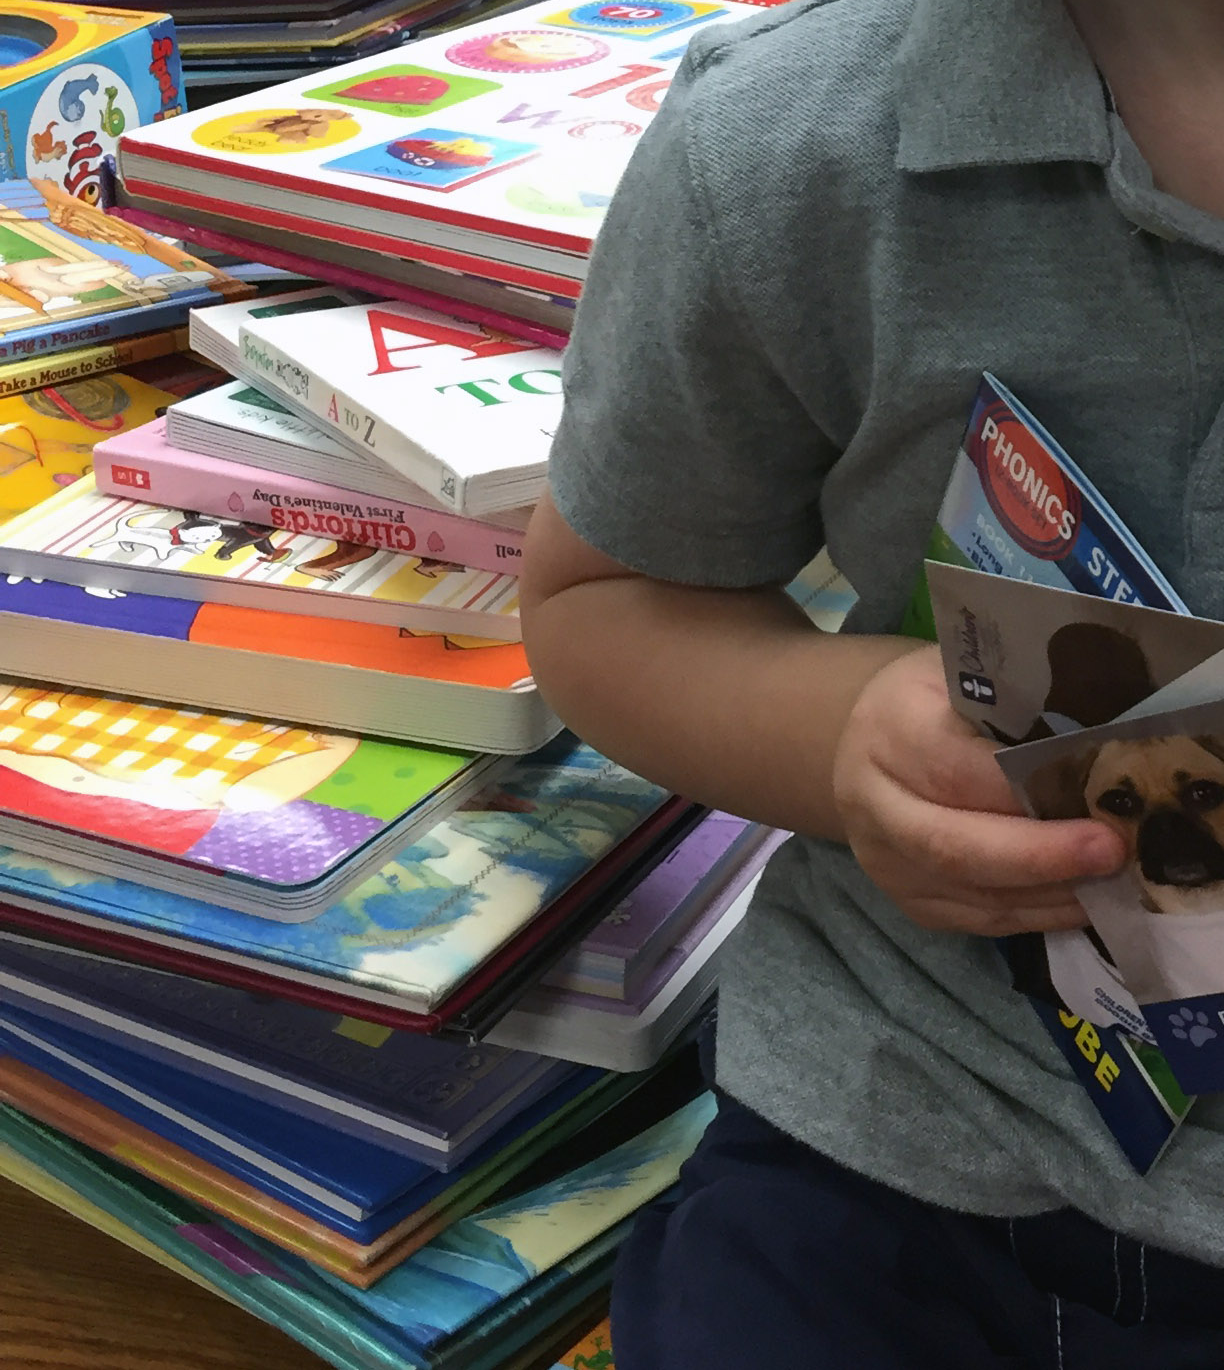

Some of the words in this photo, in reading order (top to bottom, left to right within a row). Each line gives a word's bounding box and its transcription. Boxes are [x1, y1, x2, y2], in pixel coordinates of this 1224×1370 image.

[608, 6, 656, 19] 70
[12, 340, 36, 354] Pig
[51, 323, 111, 346] Pancake
[366, 309, 546, 377] A
[39, 365, 78, 384] Mouse
[80, 361, 93, 373] to
[327, 393, 341, 424] A
[343, 407, 361, 431] TO
[363, 415, 378, 448] Z
[981, 416, 1076, 541] PHONICS
[252, 488, 281, 508] Day
[282, 495, 363, 520] Valentine's
[270, 506, 417, 552] Clifford's
[363, 506, 405, 524] First
